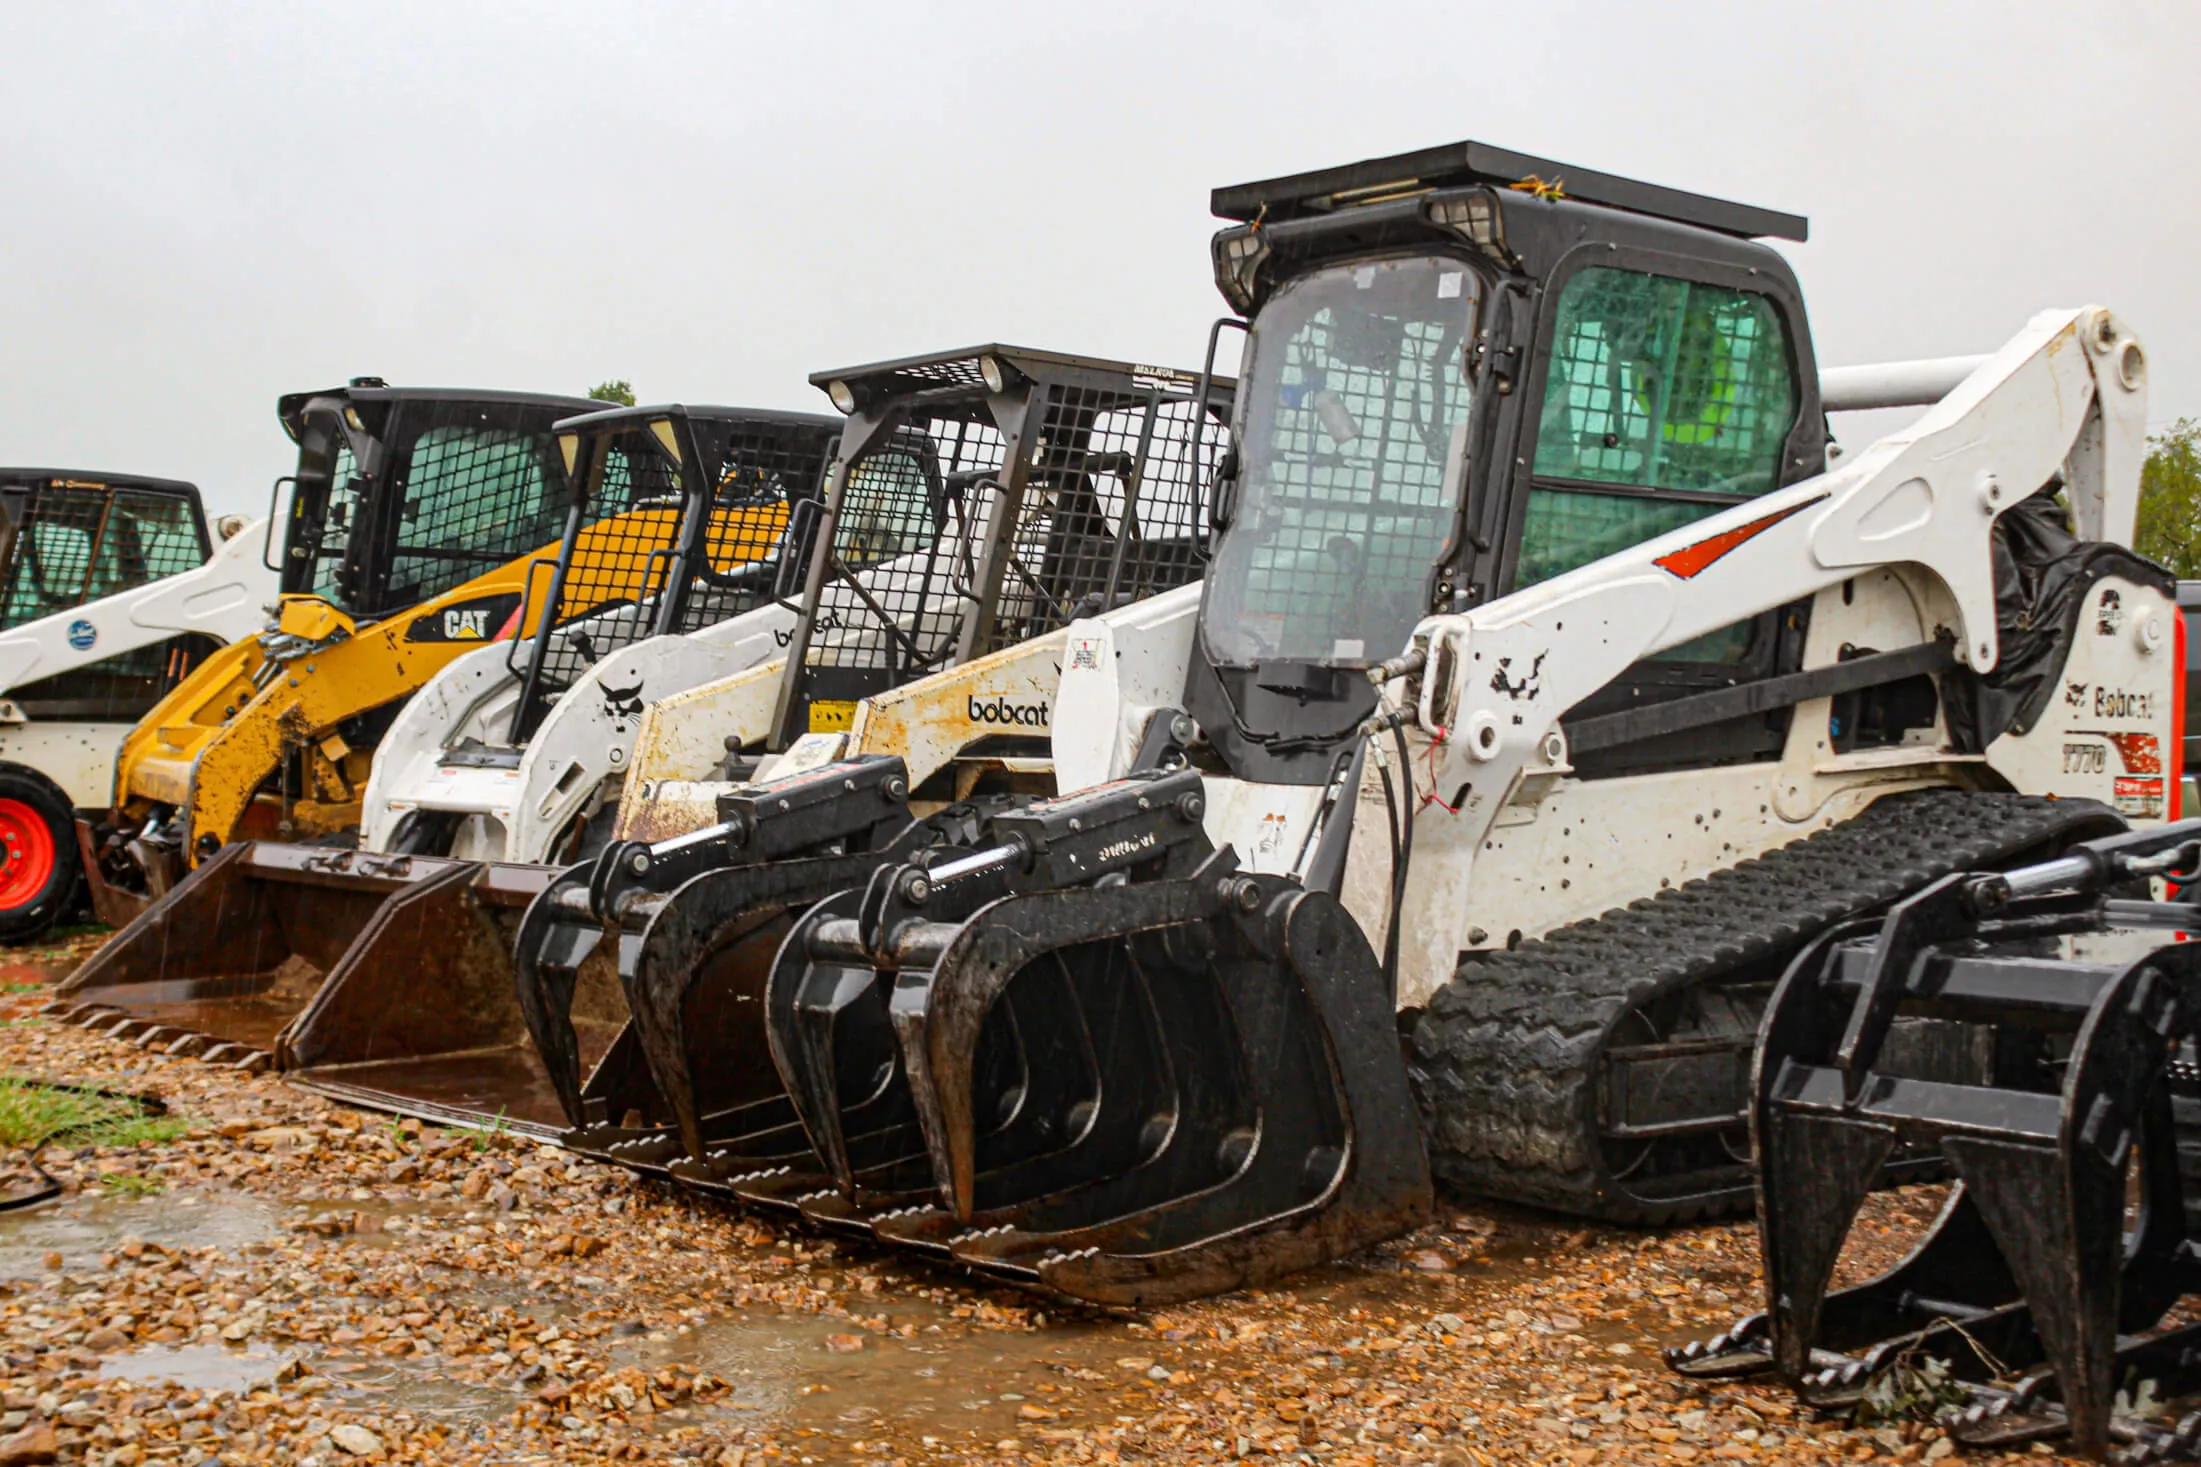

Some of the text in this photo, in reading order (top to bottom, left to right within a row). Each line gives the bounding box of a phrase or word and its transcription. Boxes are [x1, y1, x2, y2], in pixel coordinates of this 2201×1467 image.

[444, 610, 490, 639] CAT
[773, 608, 842, 648] bcat
[968, 694, 1048, 726] bobcat
[2063, 744, 2106, 773] T770
